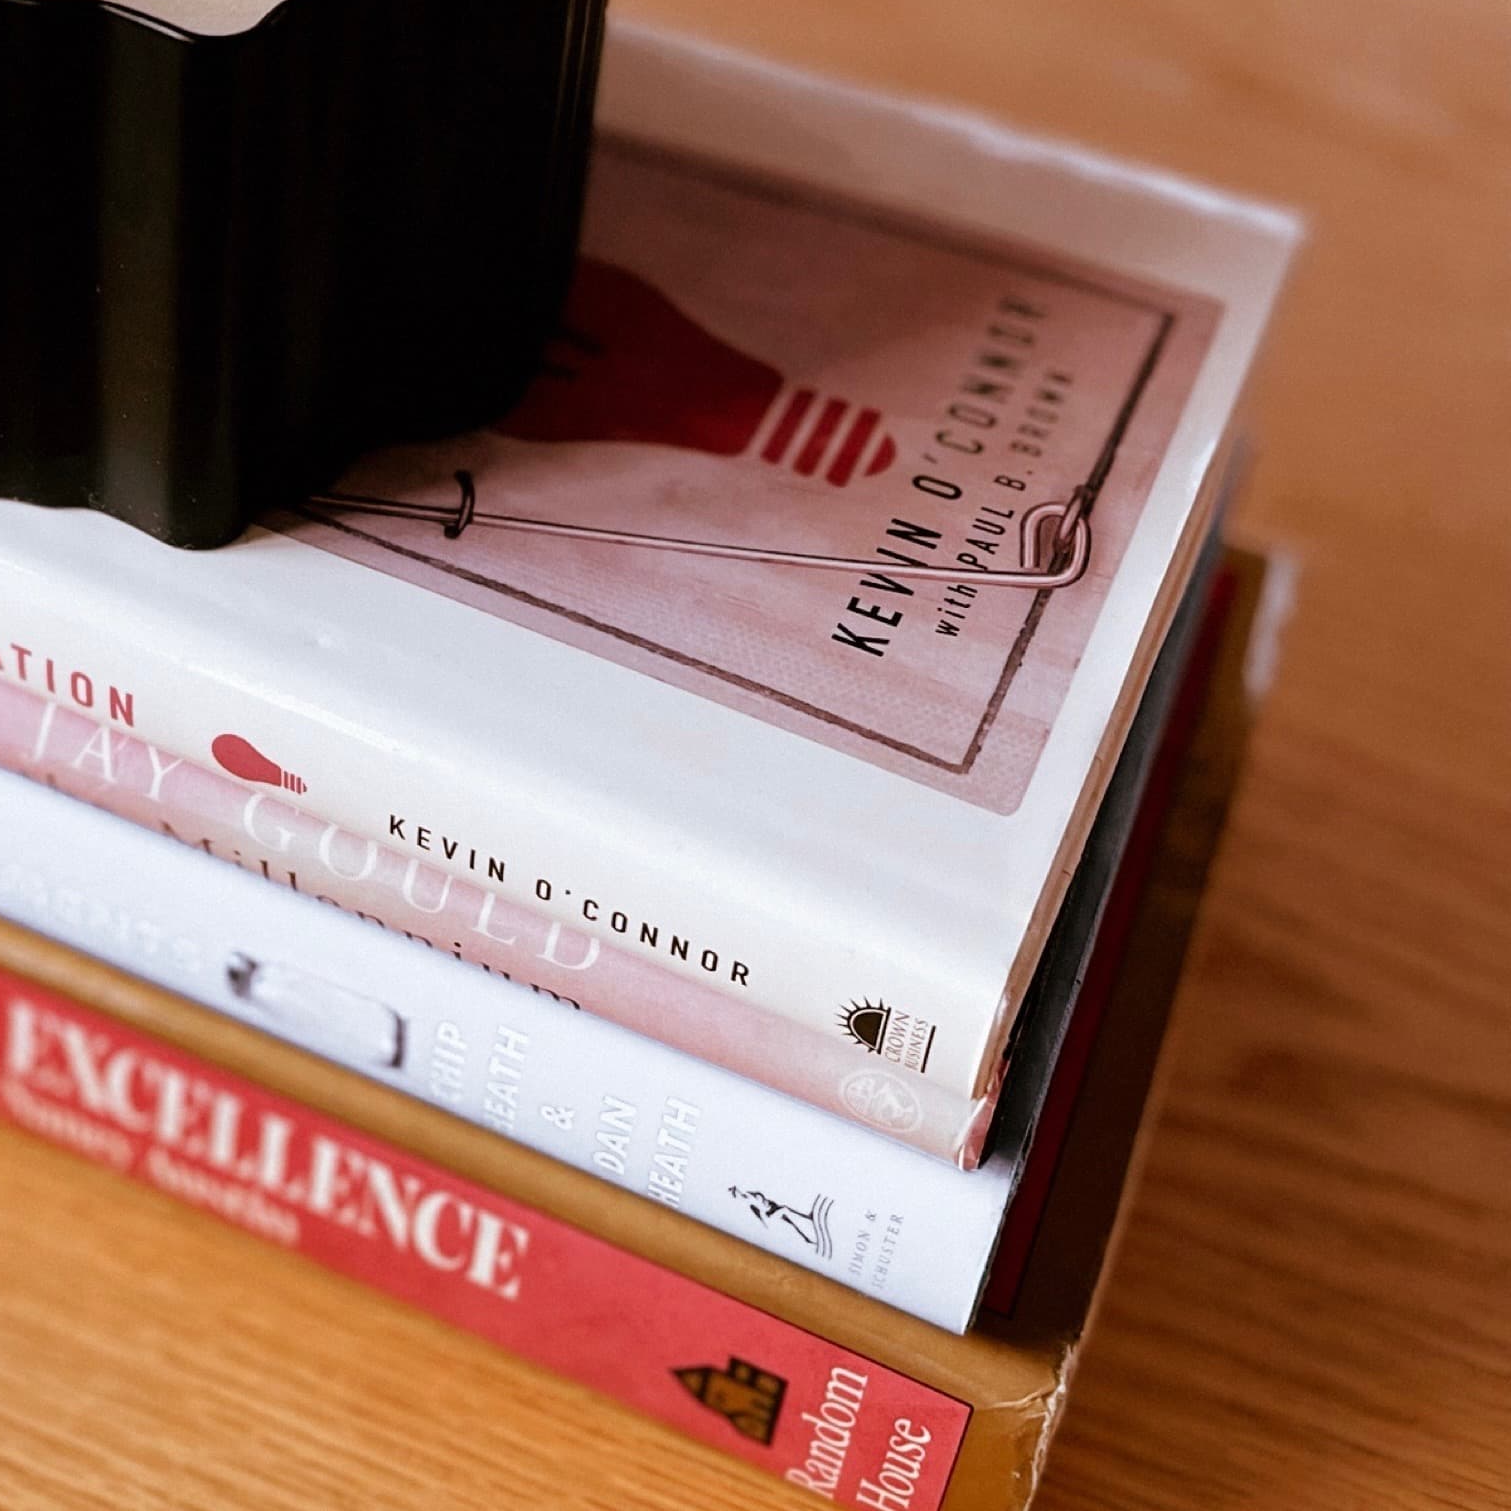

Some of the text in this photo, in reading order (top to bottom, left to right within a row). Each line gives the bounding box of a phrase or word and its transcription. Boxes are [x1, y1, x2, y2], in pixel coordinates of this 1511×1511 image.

[831, 295, 1047, 657] KEVIN O'CONNOR
[935, 585, 978, 637] with
[957, 506, 1015, 572] PAUL
[993, 469, 1033, 492] B.
[24, 700, 185, 801] JAY
[242, 792, 602, 972] GOULD
[389, 814, 752, 987] KEVIN O'CONNOR
[483, 1024, 529, 1131] HEATH
[884, 1009, 911, 1064] CROWN
[904, 1019, 930, 1071] BUSINESS
[3, 996, 530, 1302] EXCELLENCE
[539, 1104, 577, 1131] &
[592, 1094, 638, 1176] DAN
[647, 1095, 702, 1209] HEATH
[784, 1366, 868, 1501] Random
[855, 1417, 932, 1511] House
